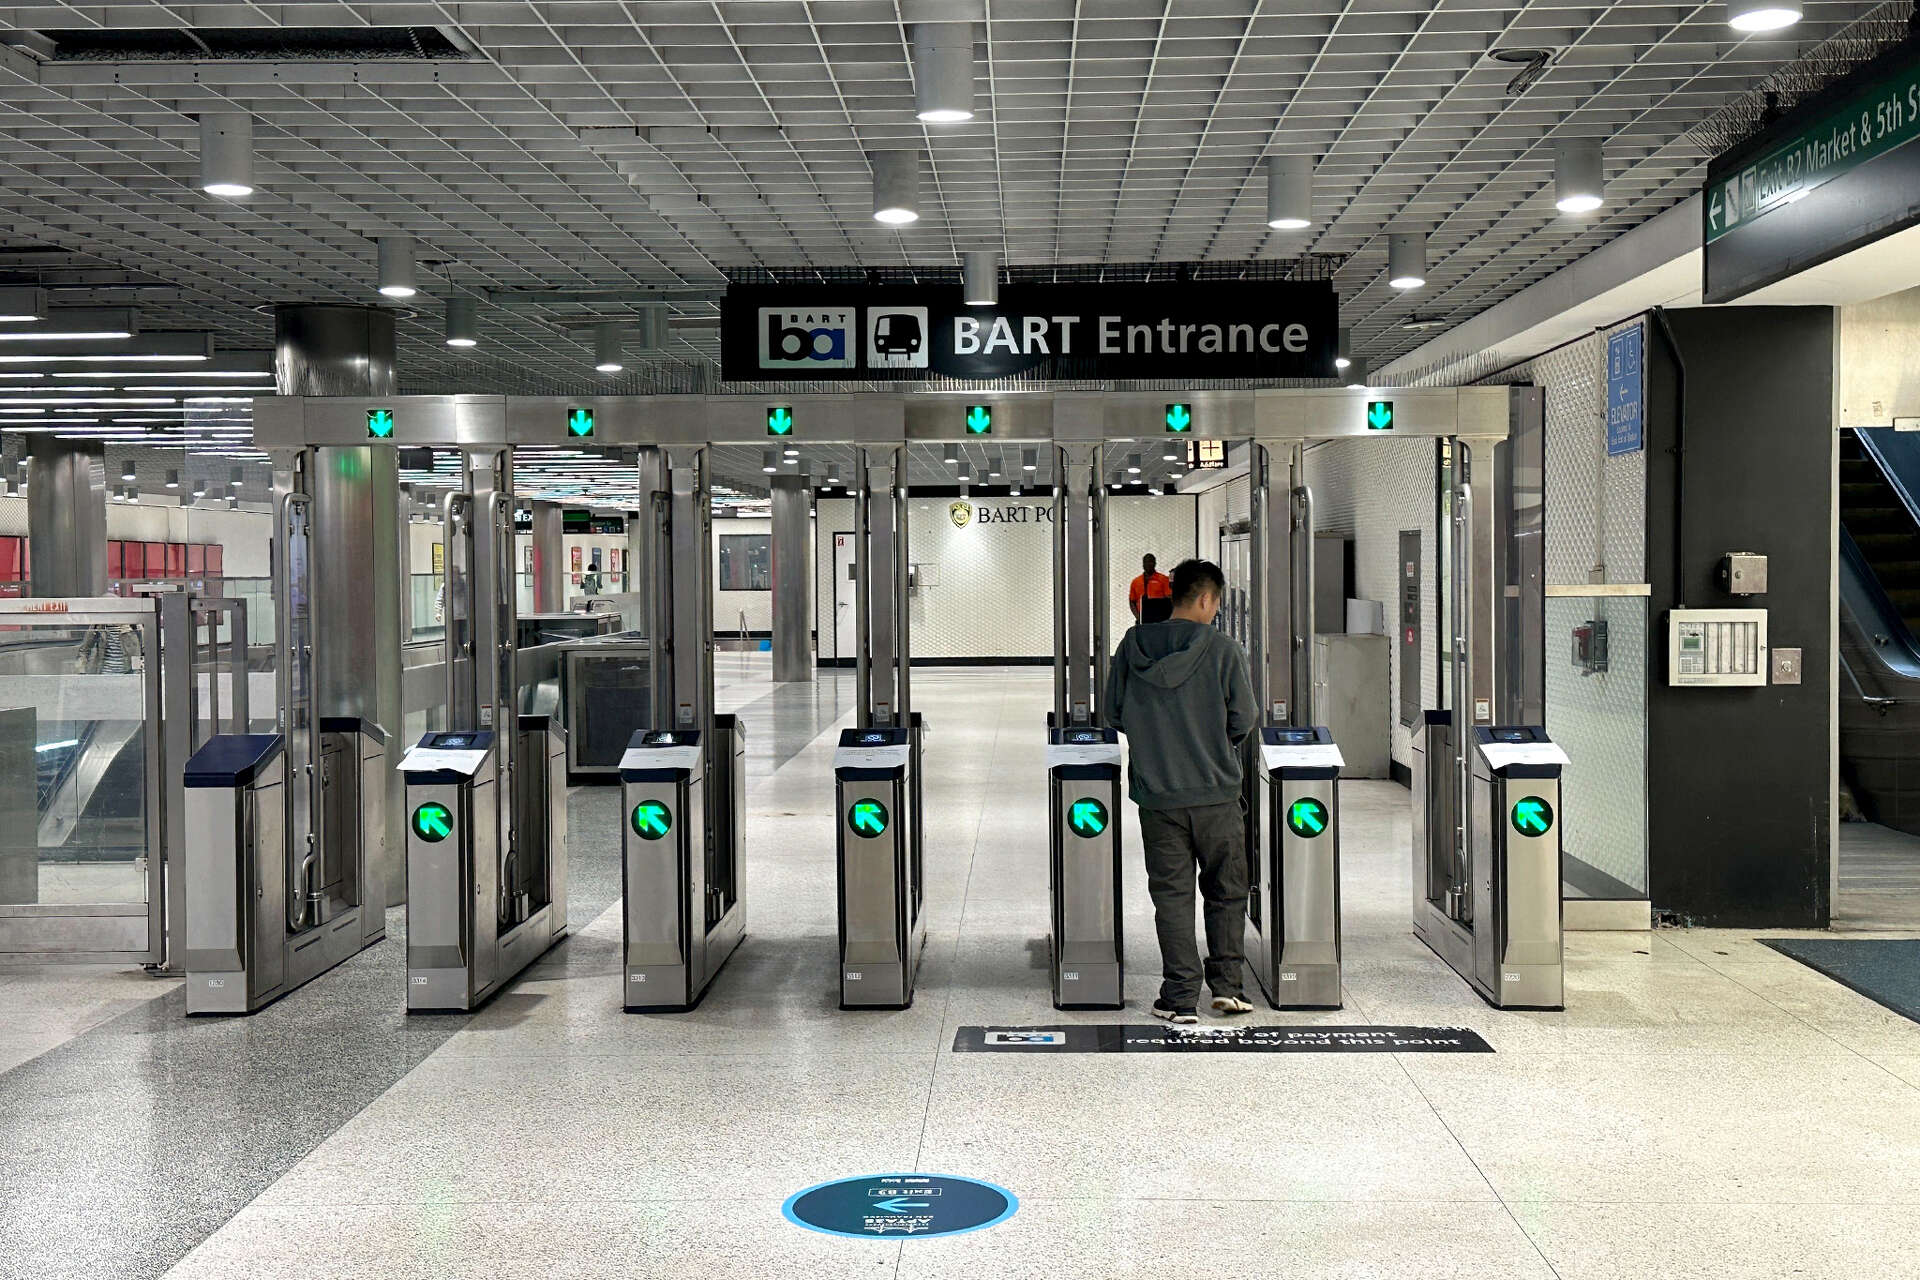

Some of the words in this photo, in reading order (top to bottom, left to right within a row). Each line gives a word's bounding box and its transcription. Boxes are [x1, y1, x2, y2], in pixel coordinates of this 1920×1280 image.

[1759, 160, 1783, 200] Exit
[1806, 121, 1857, 173] Market
[1861, 111, 1872, 146] &
[1876, 93, 1902, 139] 5th
[1908, 83, 1920, 122] S
[790, 314, 846, 323] BART
[953, 315, 1081, 356] BART
[1099, 315, 1309, 355] Entrance
[978, 506, 1031, 523] BART
[1126, 1037, 1230, 1045] required
[1238, 1038, 1331, 1046] beyond
[1287, 1031, 1398, 1039] payment
